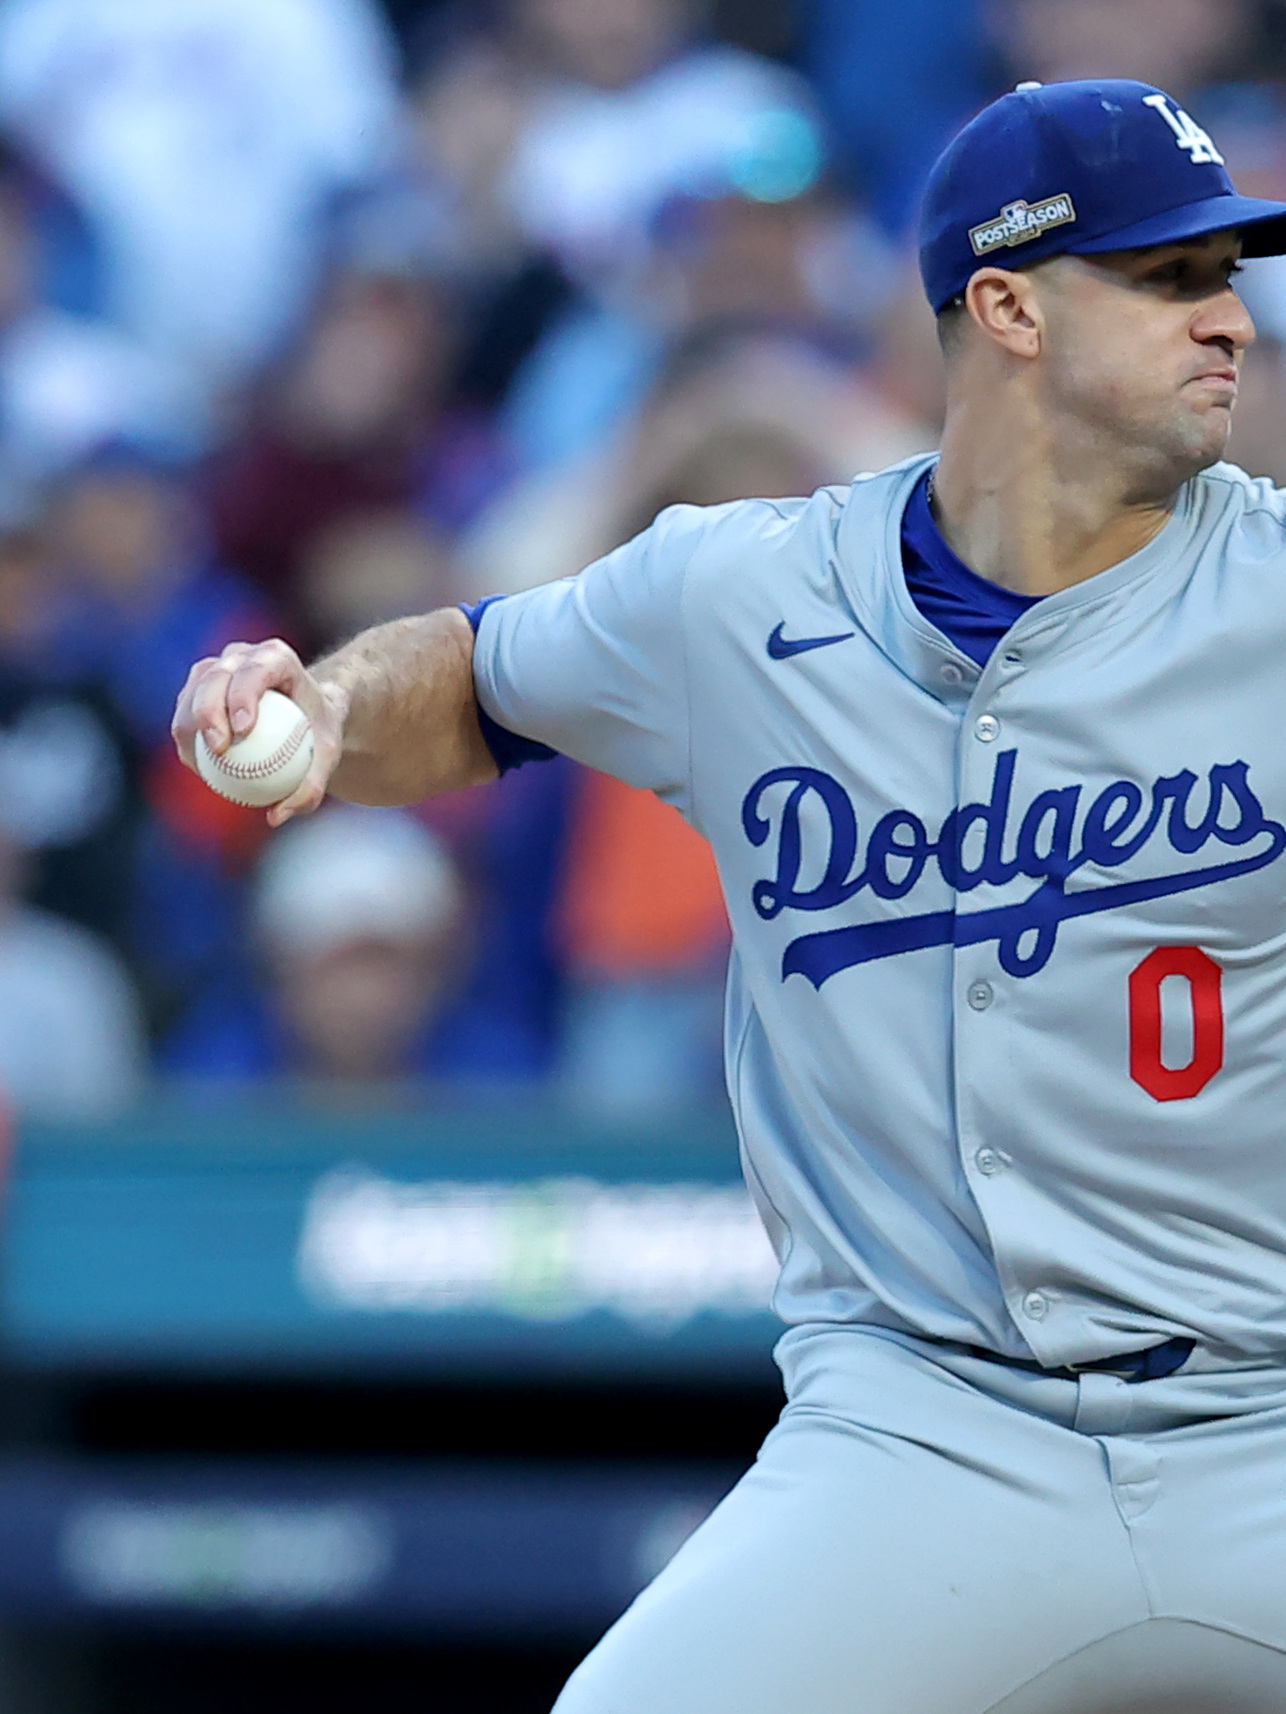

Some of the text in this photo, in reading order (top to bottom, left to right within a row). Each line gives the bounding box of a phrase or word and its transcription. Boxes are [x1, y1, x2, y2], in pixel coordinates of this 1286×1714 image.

[1142, 94, 1224, 166] LA
[973, 199, 1070, 250] POSTSEASON
[1128, 945, 1223, 1102] 0
